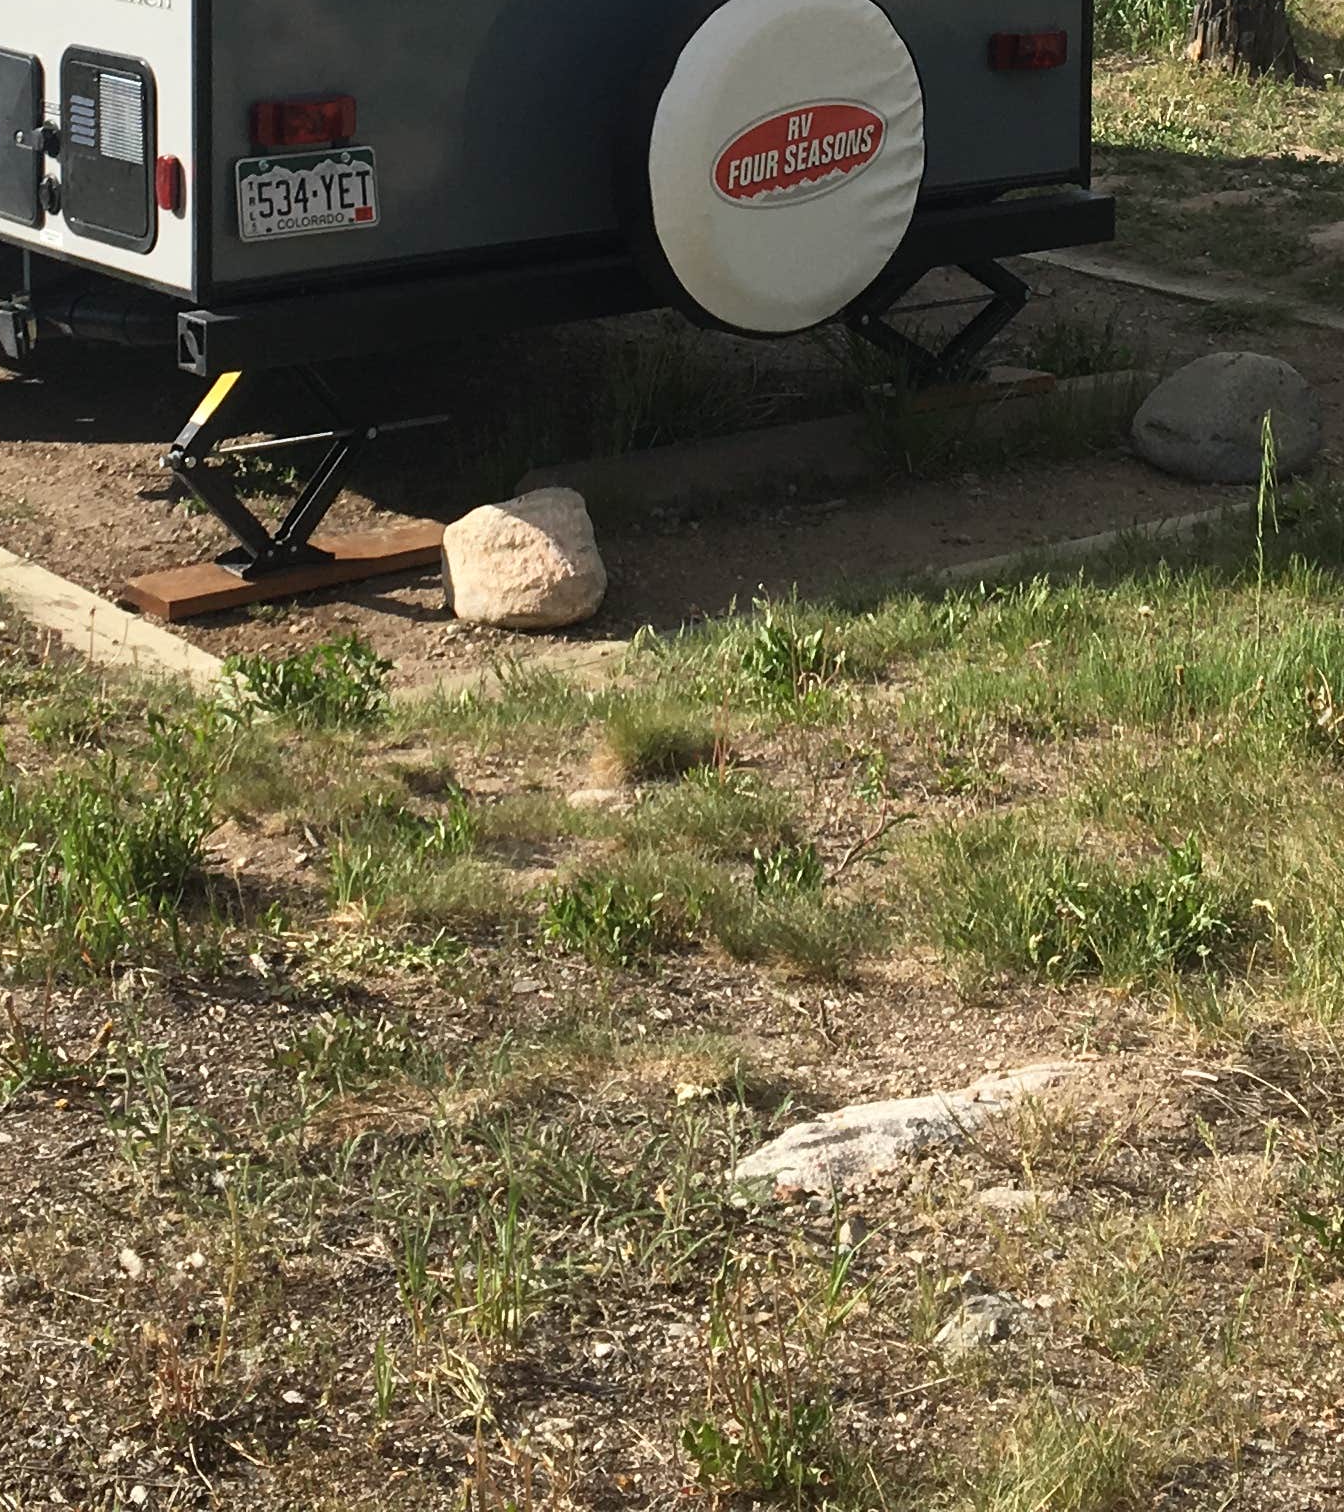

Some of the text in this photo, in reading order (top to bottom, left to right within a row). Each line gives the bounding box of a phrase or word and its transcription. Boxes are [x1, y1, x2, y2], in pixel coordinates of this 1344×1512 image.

[787, 112, 814, 141] RV
[728, 124, 875, 190] FOUR SEASONS
[277, 212, 345, 231] COLORADO
